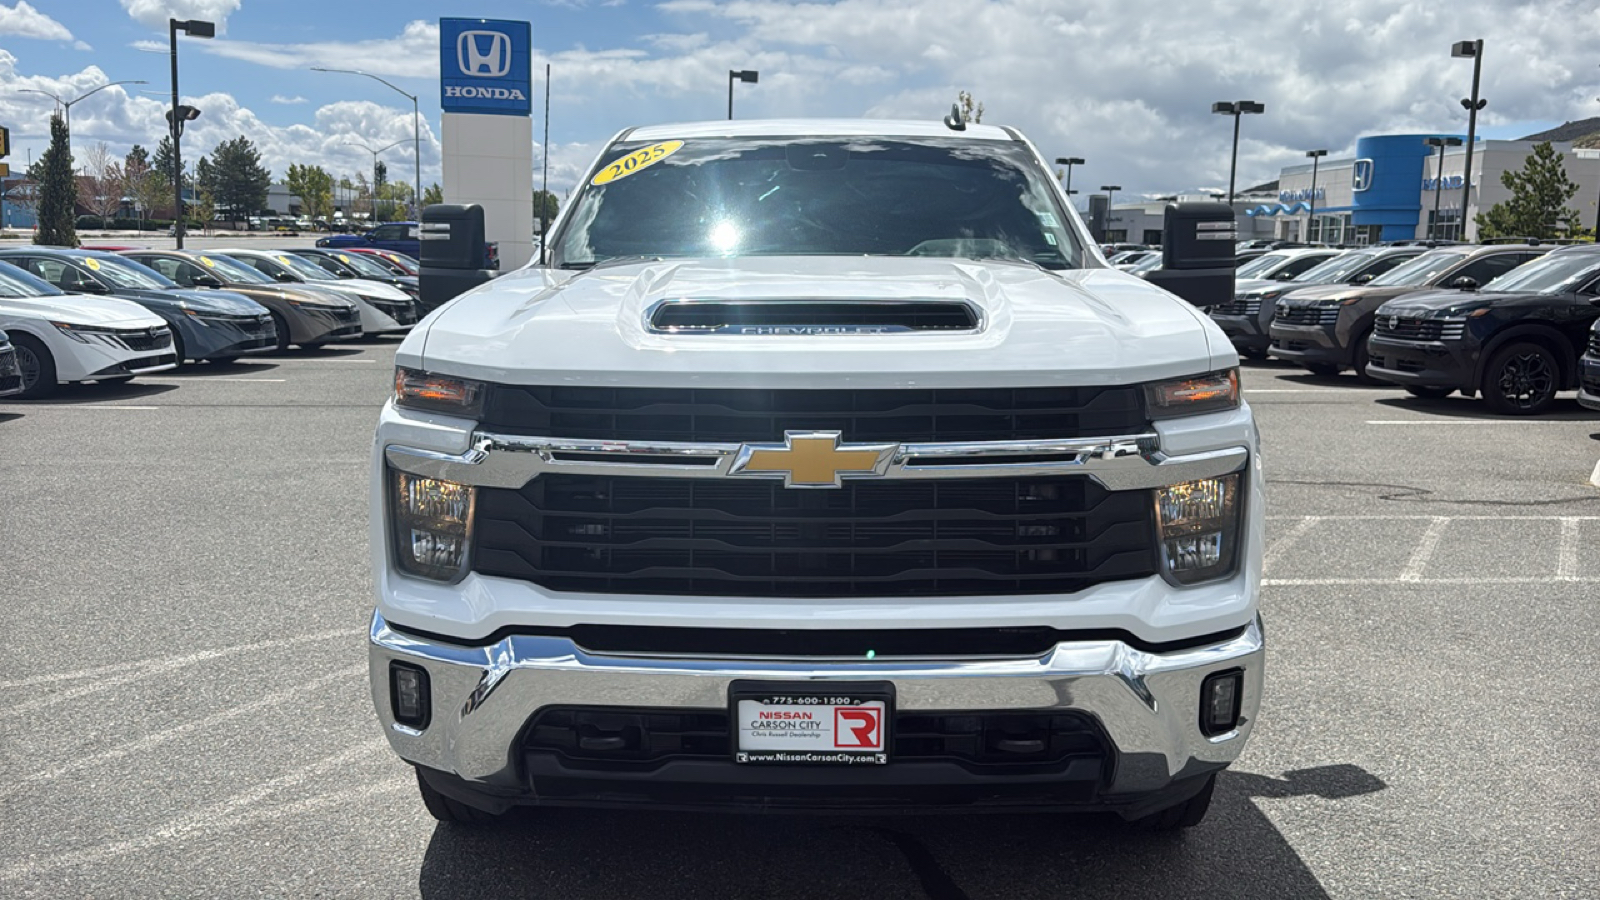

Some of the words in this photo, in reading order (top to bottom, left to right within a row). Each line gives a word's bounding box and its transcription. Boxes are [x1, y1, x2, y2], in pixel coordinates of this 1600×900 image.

[444, 86, 526, 101] HONDA
[609, 145, 665, 179] 2025
[1423, 175, 1477, 191] HOND
[741, 327, 888, 335] CHEVROLET
[772, 696, 851, 705] 775-600-1500
[759, 711, 812, 720] NISSAN
[750, 720, 796, 730] CARSON
[799, 720, 821, 730] CITY
[749, 753, 875, 764] www.NissanCarsonCity.com
